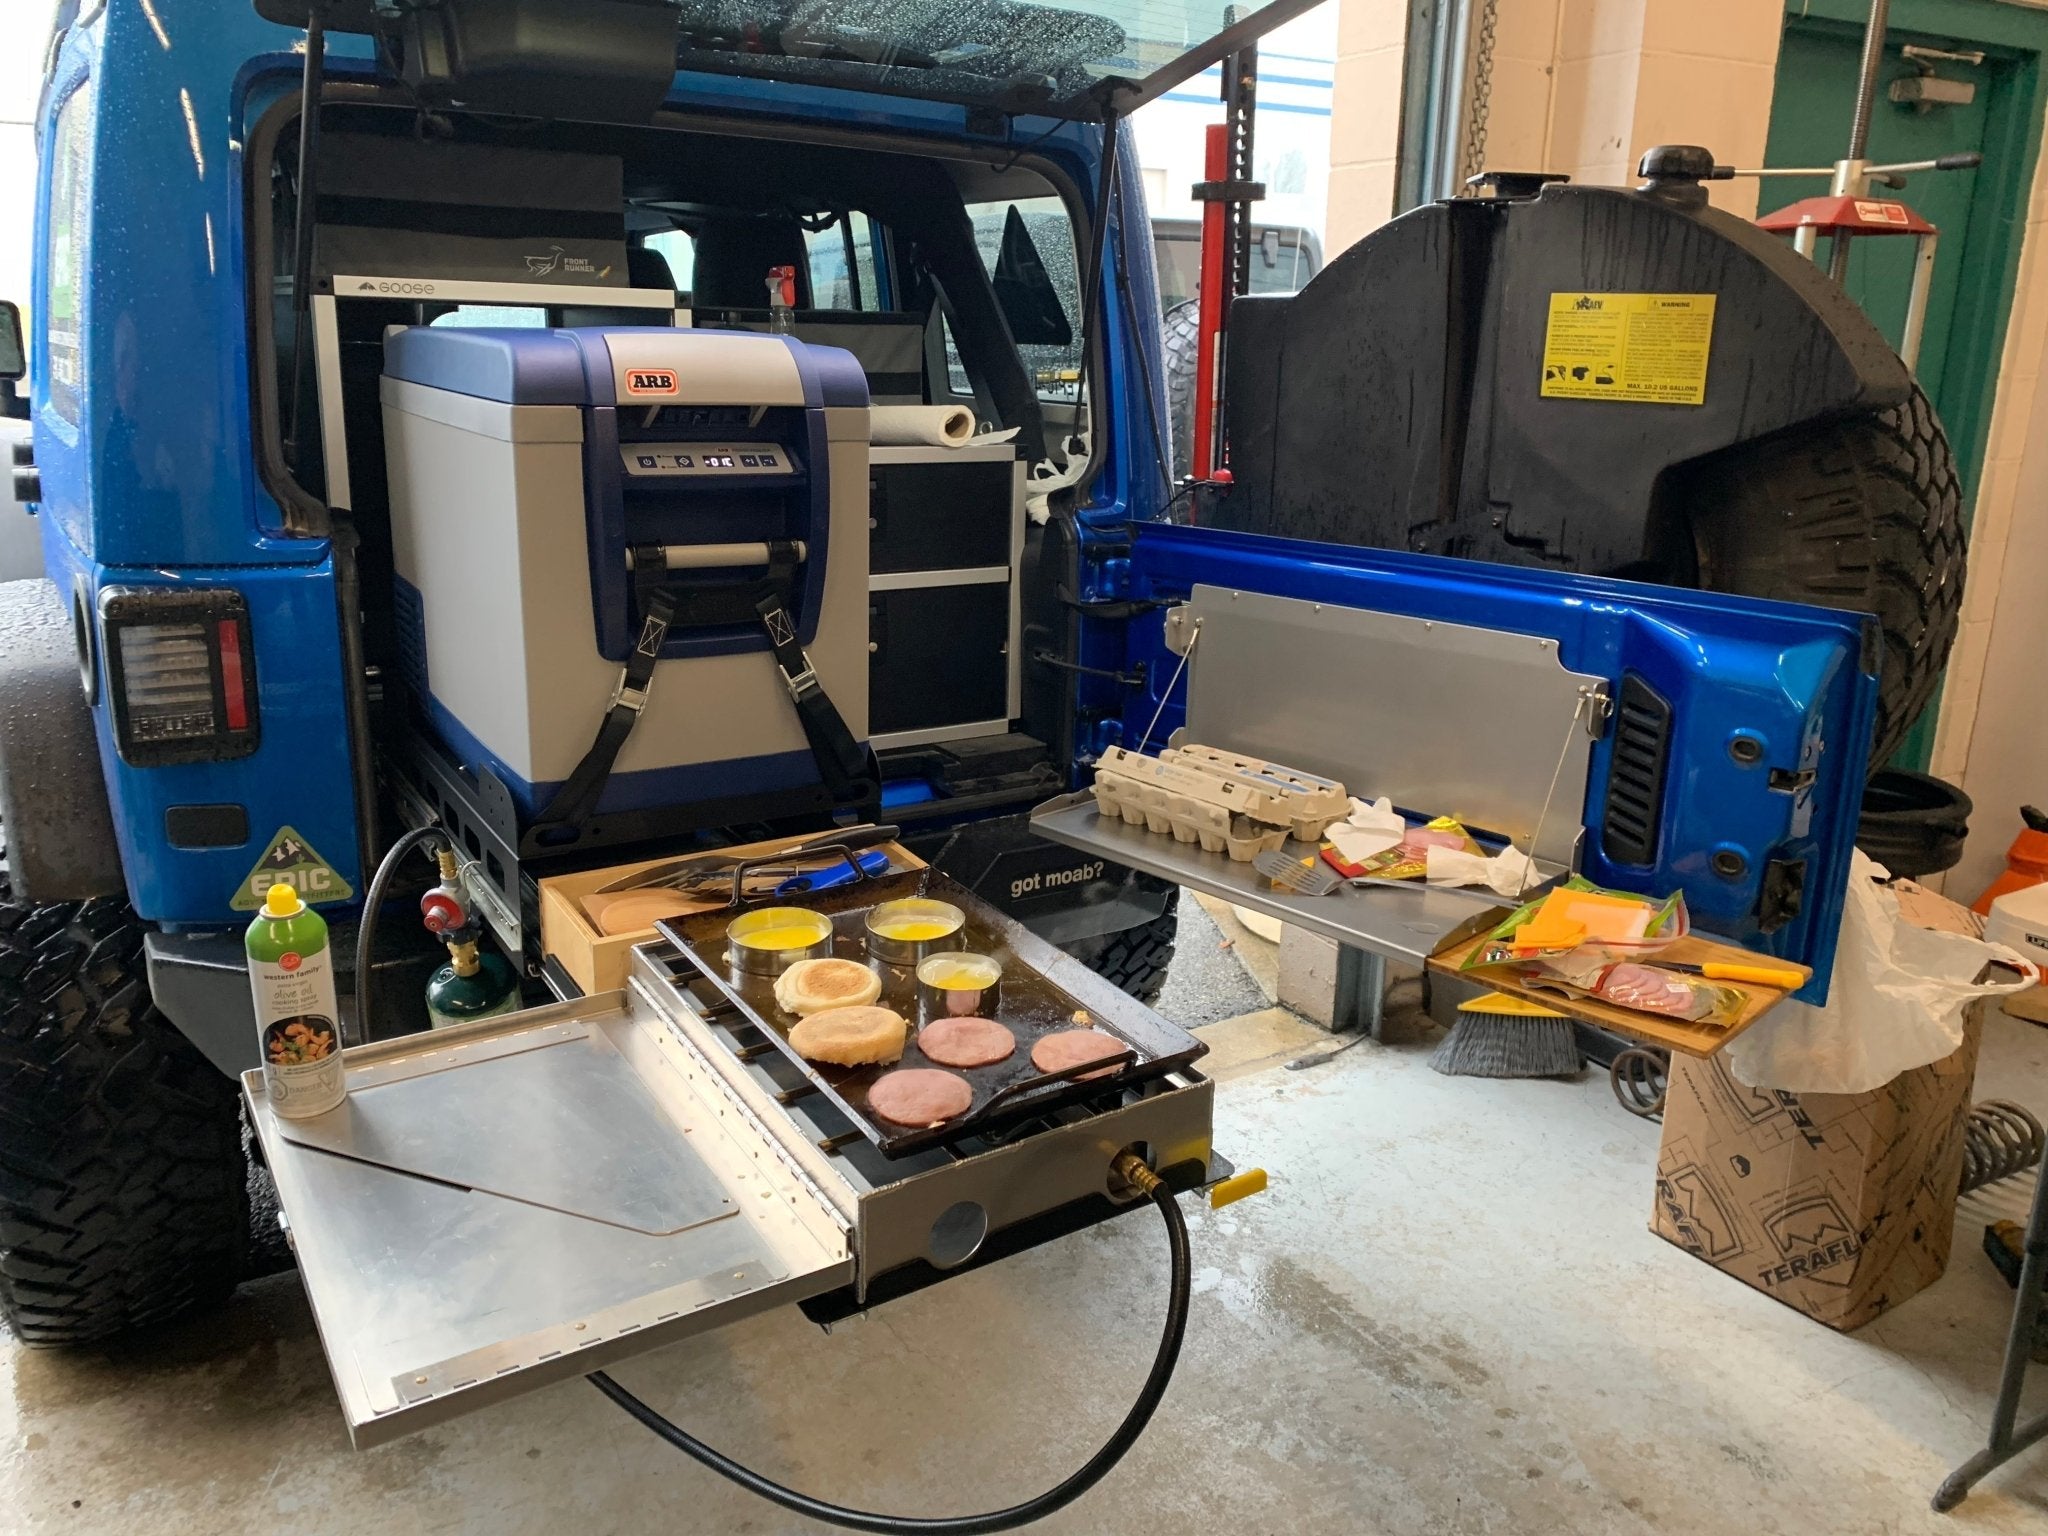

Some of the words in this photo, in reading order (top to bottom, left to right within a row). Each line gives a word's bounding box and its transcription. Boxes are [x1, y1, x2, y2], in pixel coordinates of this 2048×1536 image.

[564, 257, 588, 265] FRONT
[564, 264, 595, 272] RUNNER
[633, 374, 672, 388] ARB
[251, 867, 331, 897] EPIC
[1010, 872, 1042, 898] got
[1045, 861, 1105, 888] moab?
[264, 973, 295, 981] western
[296, 965, 320, 978] family
[273, 989, 297, 999] olive
[300, 994, 318, 1004] spray
[1758, 1204, 1893, 1287] TERAFLEX
